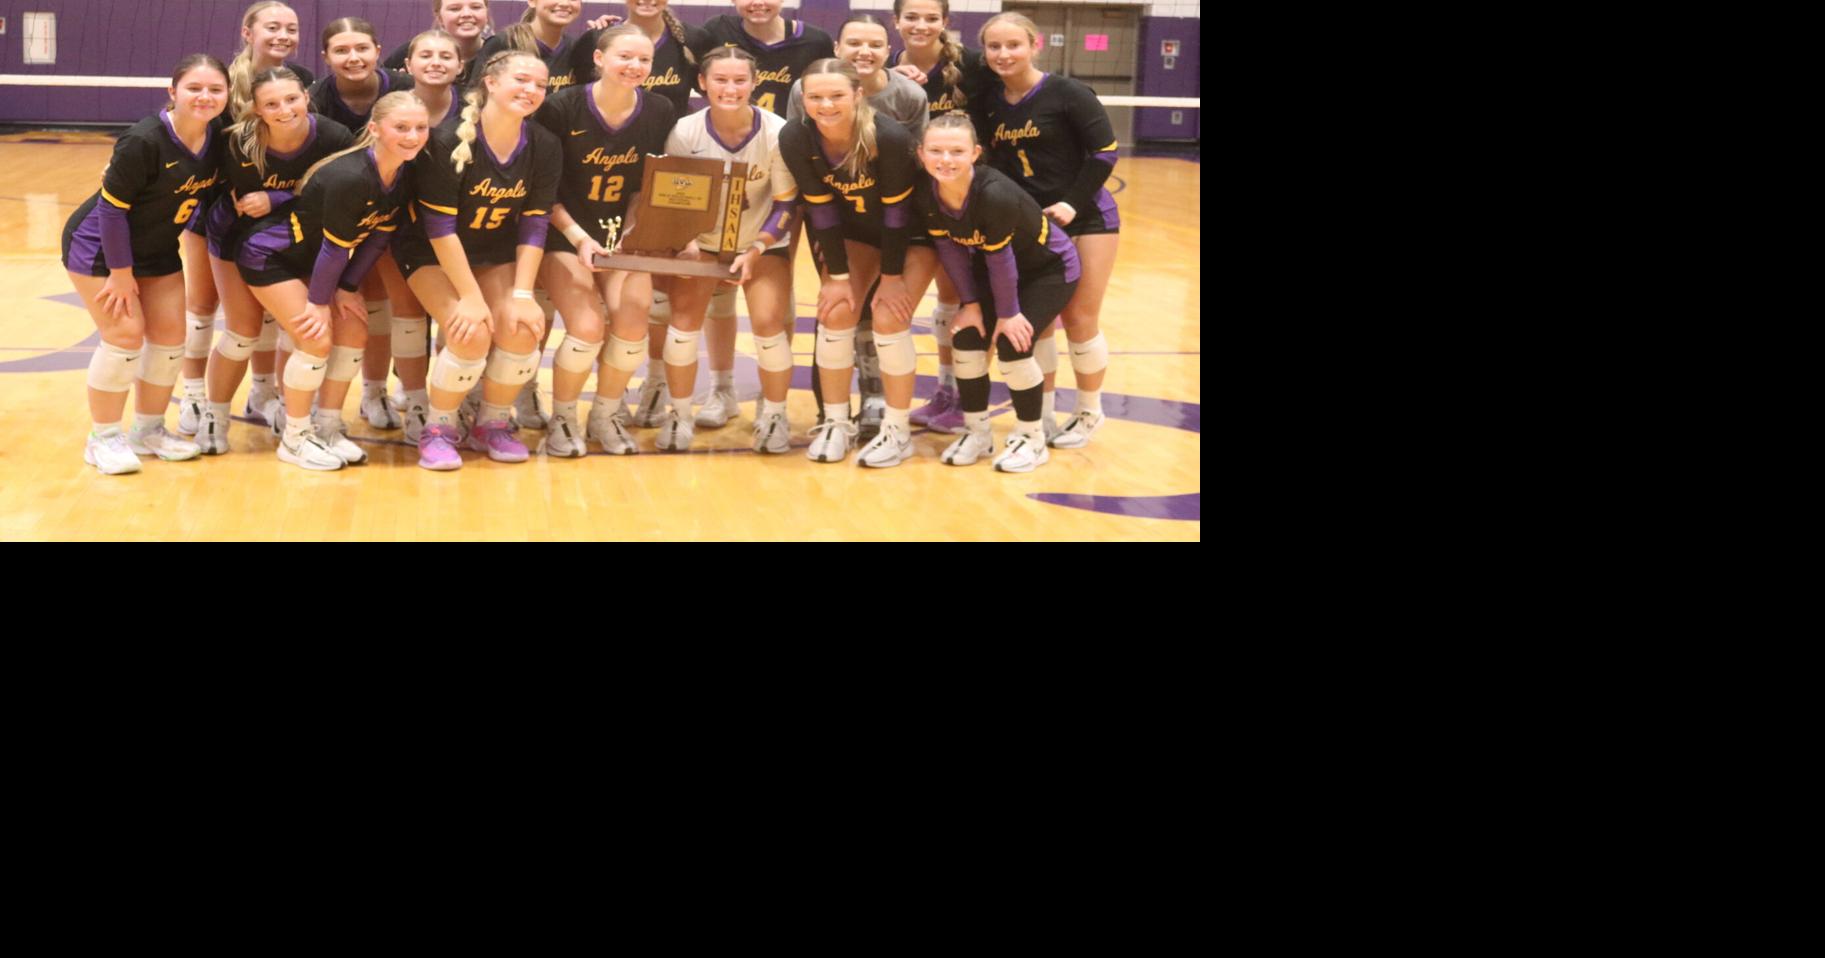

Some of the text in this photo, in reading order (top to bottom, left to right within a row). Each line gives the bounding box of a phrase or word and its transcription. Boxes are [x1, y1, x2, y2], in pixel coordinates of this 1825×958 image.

[642, 66, 681, 92] gola
[754, 66, 793, 87] gola
[757, 92, 776, 113] 4
[995, 120, 1041, 146] Angola
[581, 146, 640, 172] Angola
[1017, 149, 1034, 178] 1
[469, 178, 527, 204] Angola
[588, 175, 625, 202] 12
[823, 174, 876, 195] Angola
[174, 198, 199, 224] 6
[723, 180, 741, 249] IHSAA
[844, 195, 867, 214] 7
[469, 207, 512, 230] 15
